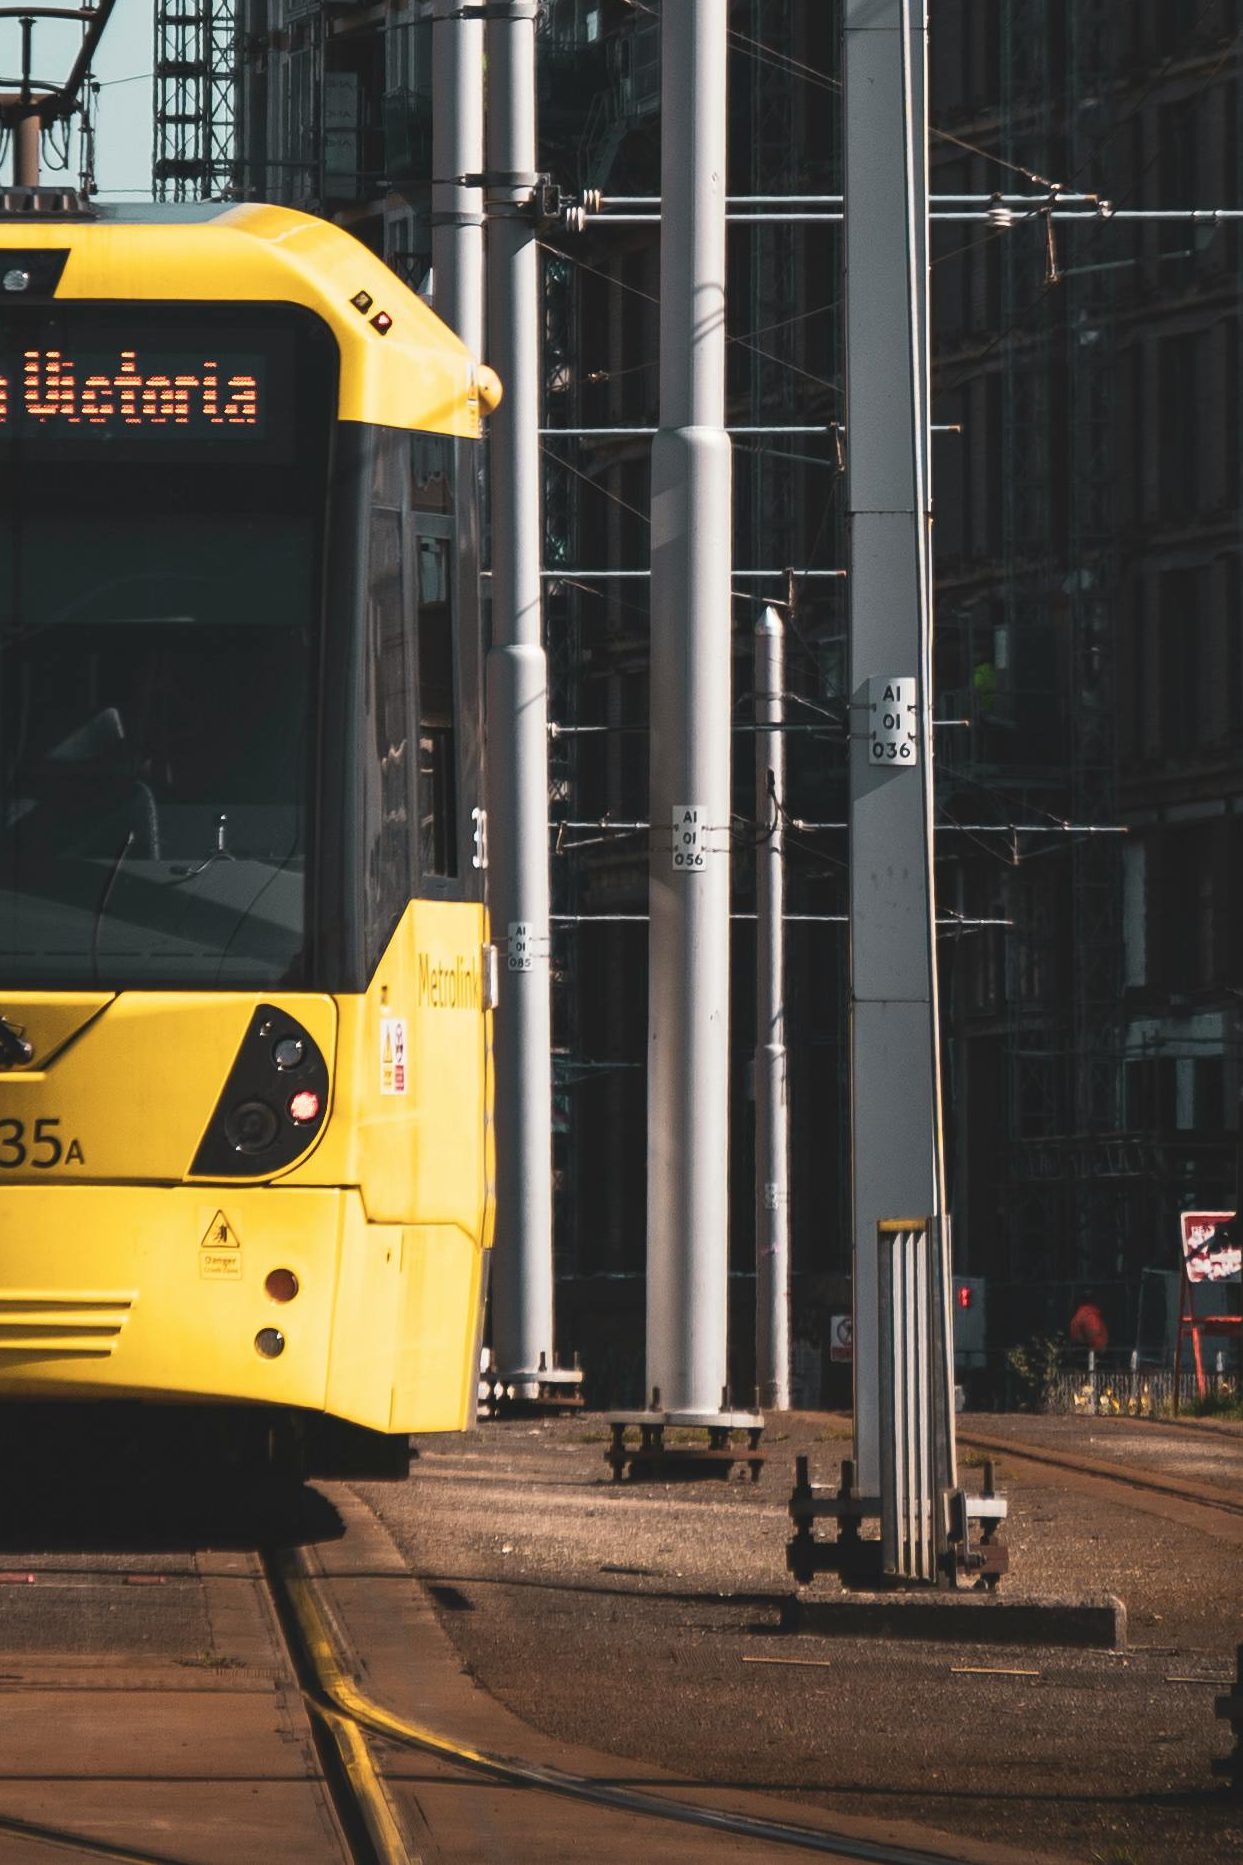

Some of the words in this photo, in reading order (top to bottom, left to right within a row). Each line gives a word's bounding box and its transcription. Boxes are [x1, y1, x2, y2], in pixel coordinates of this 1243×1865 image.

[23, 350, 257, 424] Victoria
[872, 742, 911, 759] 036
[674, 853, 704, 866] 056
[418, 952, 479, 1009] Metrolink
